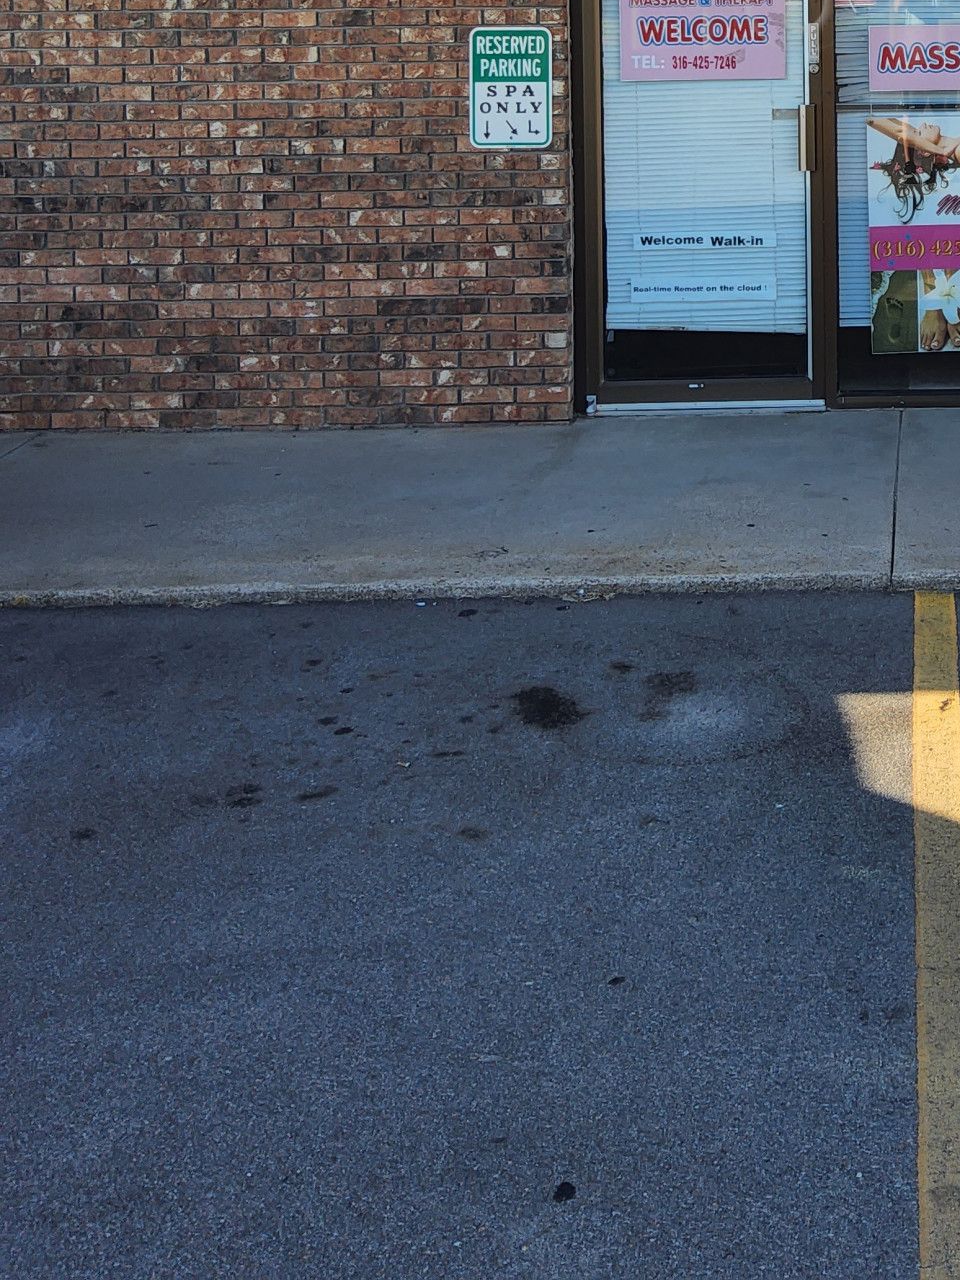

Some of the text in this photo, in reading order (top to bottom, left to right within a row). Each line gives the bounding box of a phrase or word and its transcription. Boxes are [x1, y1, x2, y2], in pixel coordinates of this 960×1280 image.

[637, 15, 768, 45] WELCOME
[476, 35, 546, 55] RESERVED
[810, 25, 818, 56] PULL
[480, 58, 542, 77] PARKING
[631, 55, 737, 70] TEL: 316-425-7246
[486, 85, 535, 97] SPA
[479, 102, 543, 114] ONLY
[640, 236, 764, 246] Welcome Walk-in
[873, 239, 925, 260] (316)
[737, 284, 762, 292] cloud
